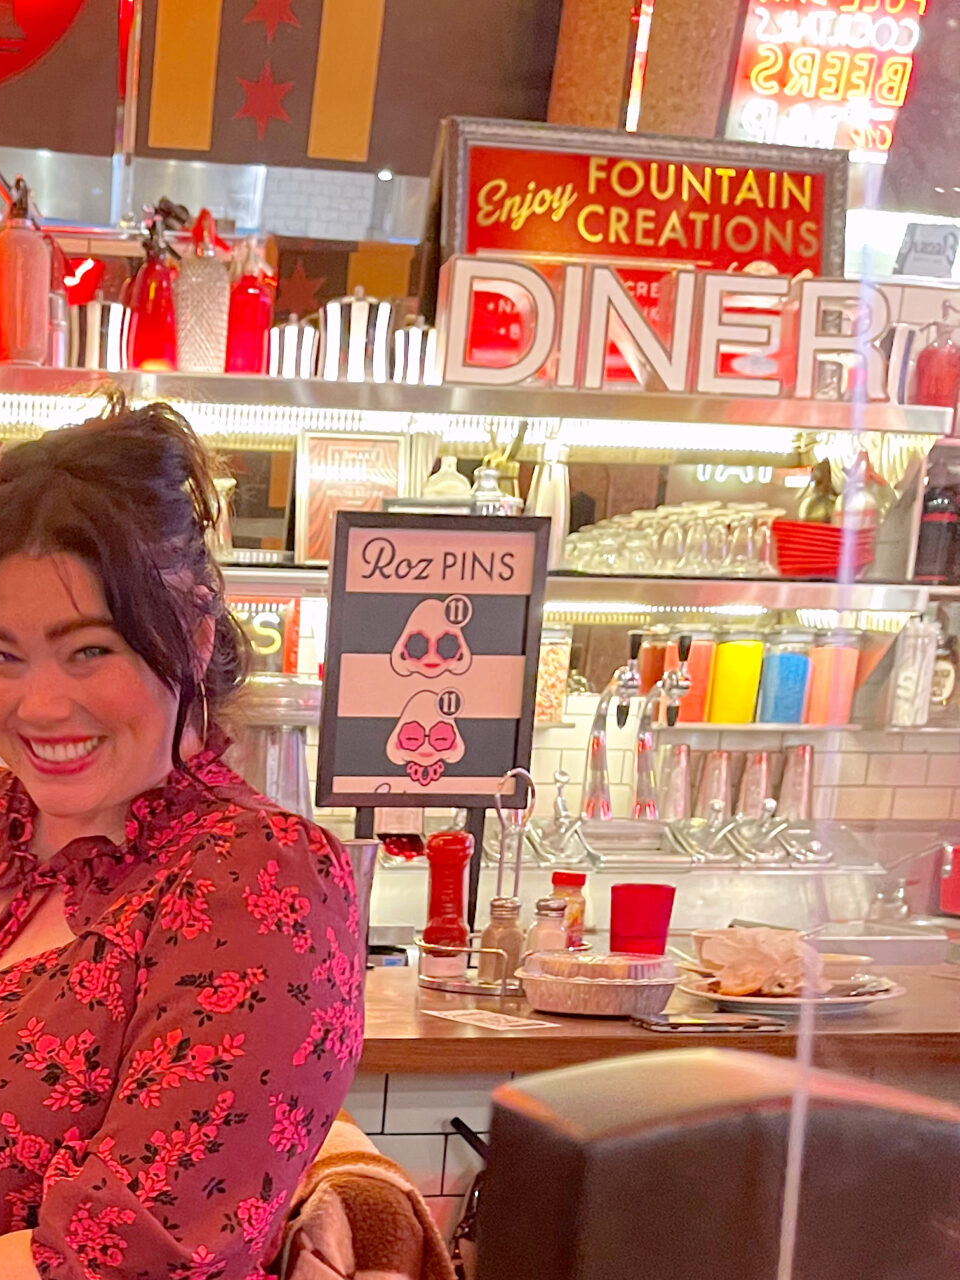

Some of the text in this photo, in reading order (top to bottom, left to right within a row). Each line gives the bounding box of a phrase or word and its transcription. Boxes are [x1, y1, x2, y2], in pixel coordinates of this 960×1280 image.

[476, 178, 578, 231] Enjoy
[588, 157, 813, 213] FOUNTAIN
[577, 204, 819, 257] CREATIONS
[443, 257, 891, 402] DINER
[361, 537, 515, 582] Roz PINS
